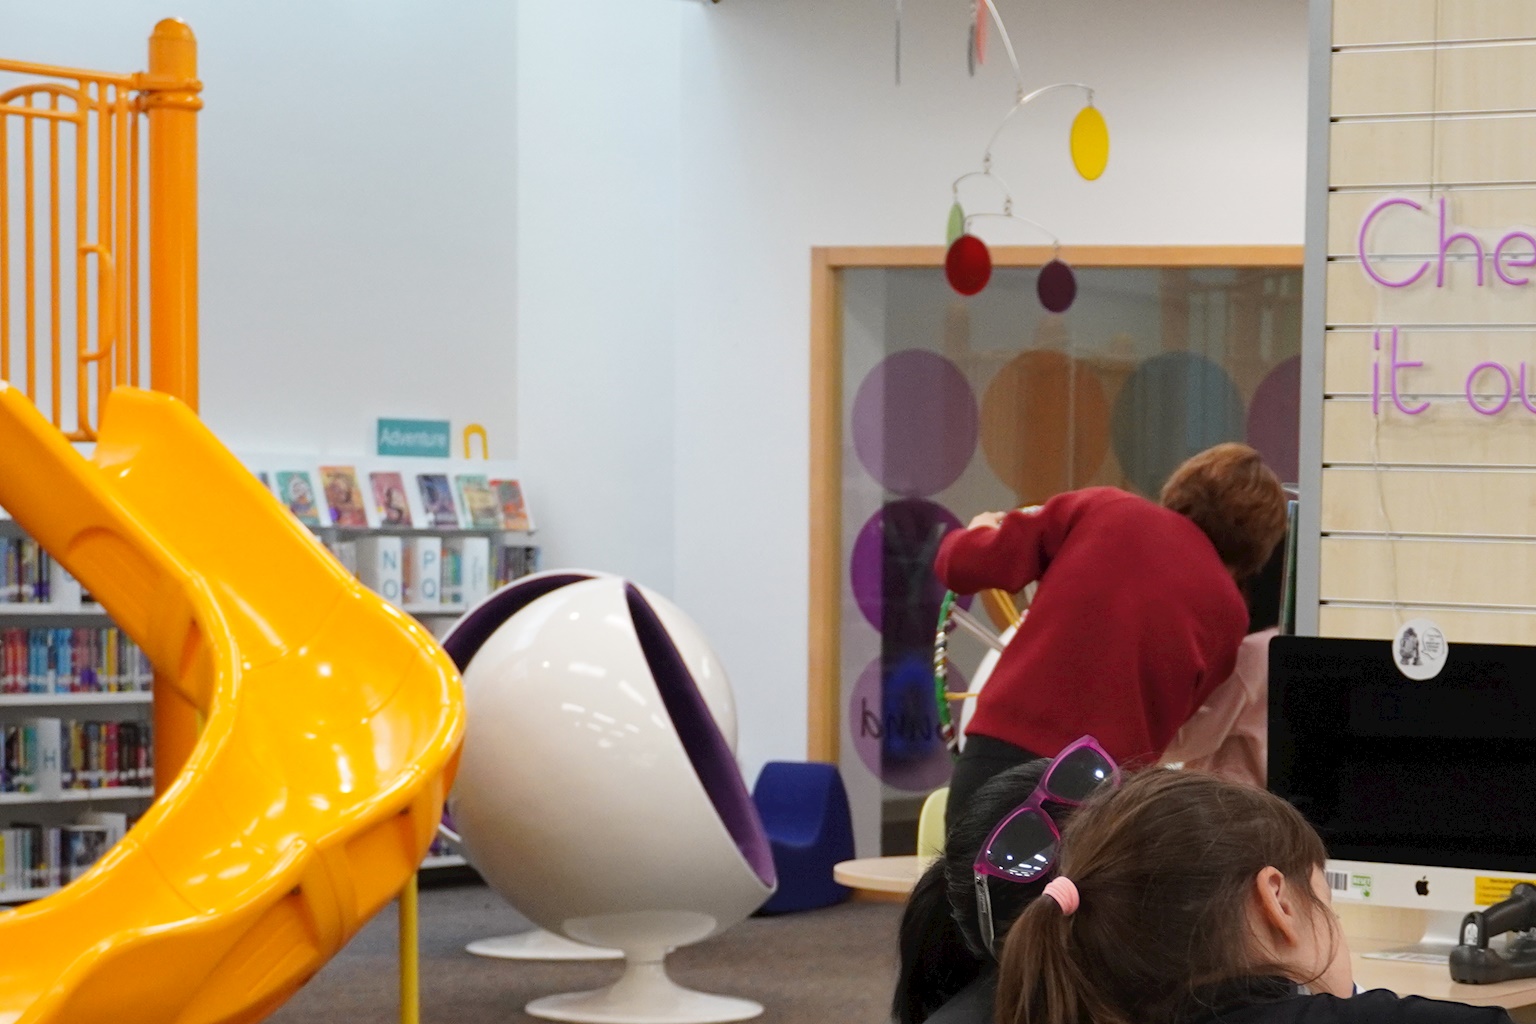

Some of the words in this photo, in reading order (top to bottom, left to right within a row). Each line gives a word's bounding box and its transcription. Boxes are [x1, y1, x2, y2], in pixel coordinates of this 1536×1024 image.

[1372, 326, 1430, 415] it
[379, 425, 447, 448] Adventure
[383, 549, 397, 569] N
[423, 549, 436, 570] P
[44, 747, 57, 769] H
